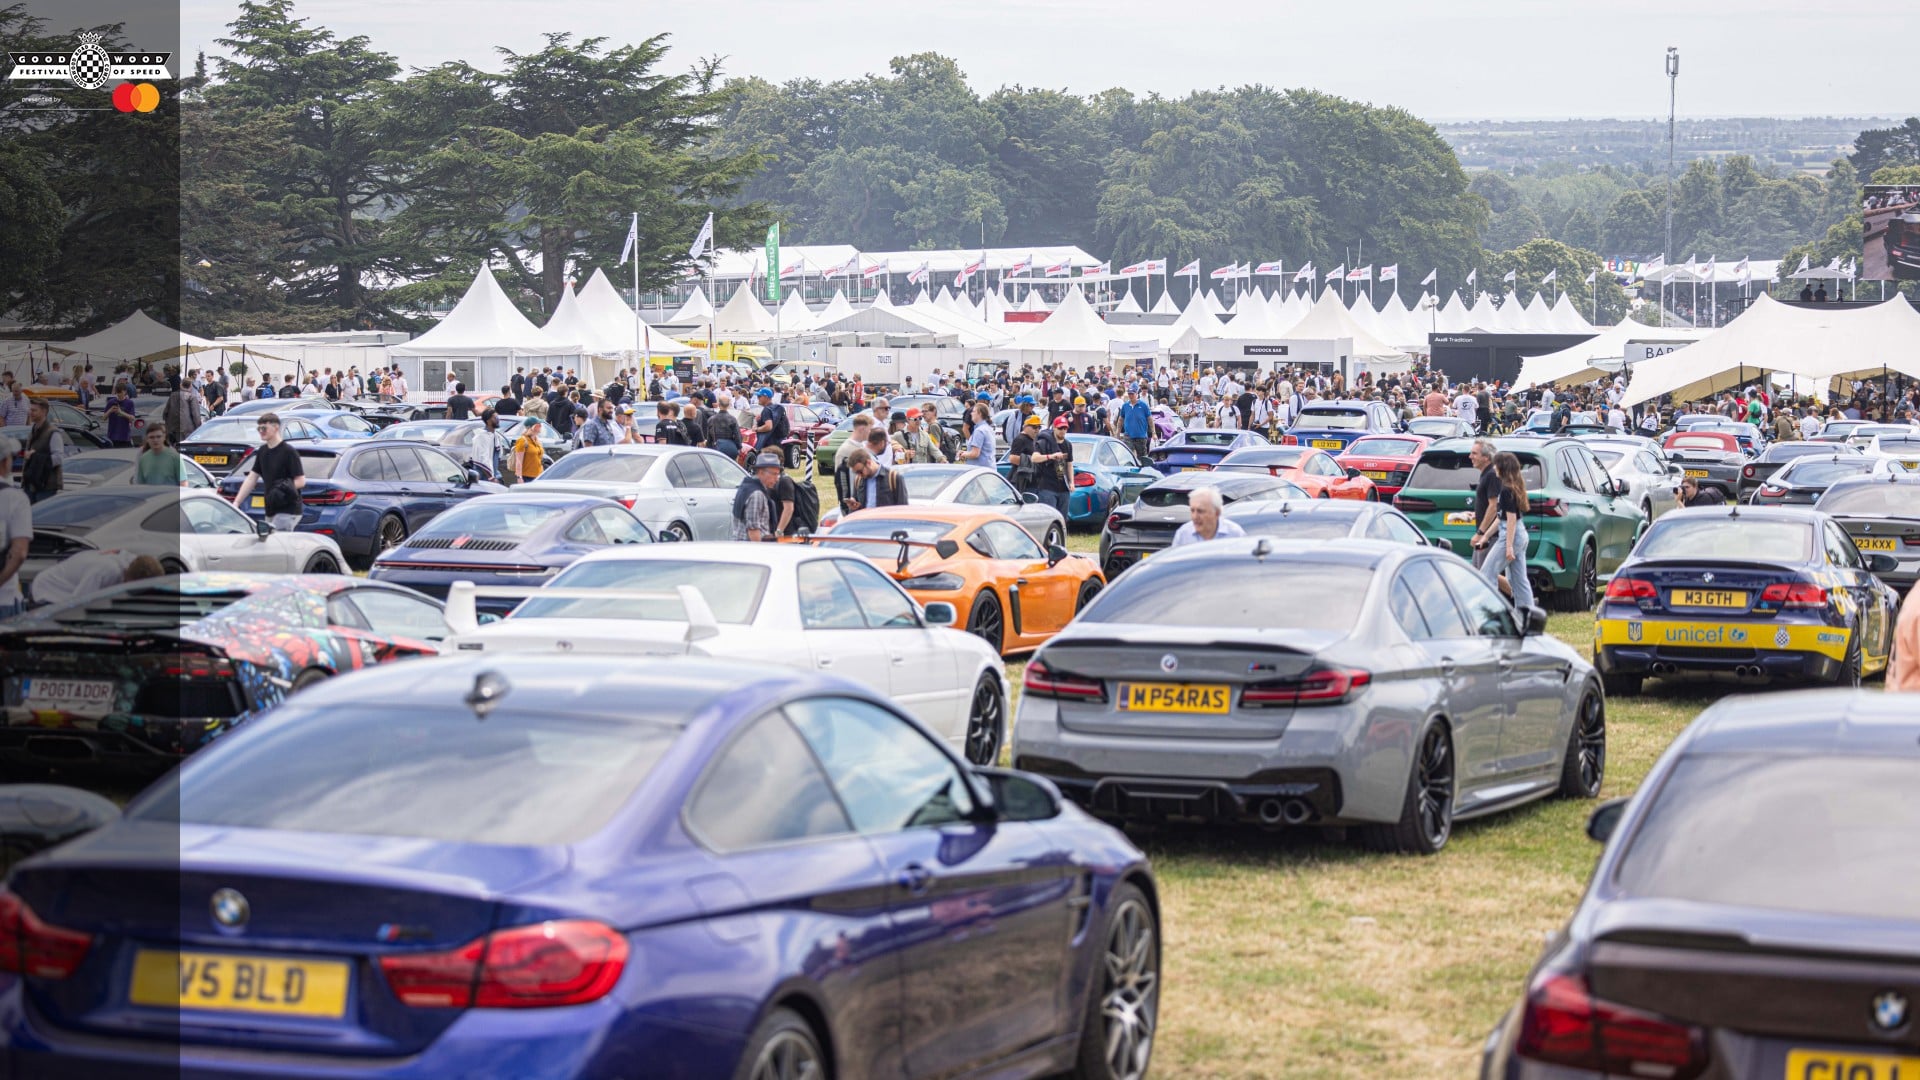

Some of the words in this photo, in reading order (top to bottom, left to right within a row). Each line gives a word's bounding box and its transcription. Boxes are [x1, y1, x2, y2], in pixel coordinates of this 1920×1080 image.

[1608, 255, 1640, 276] ebay
[1872, 538, 1892, 550] KXX
[1685, 591, 1702, 604] M3
[1706, 591, 1732, 606] GTH
[1666, 625, 1724, 643] unicef
[40, 682, 109, 699] POGTADOR
[232, 962, 306, 1005] BLD
